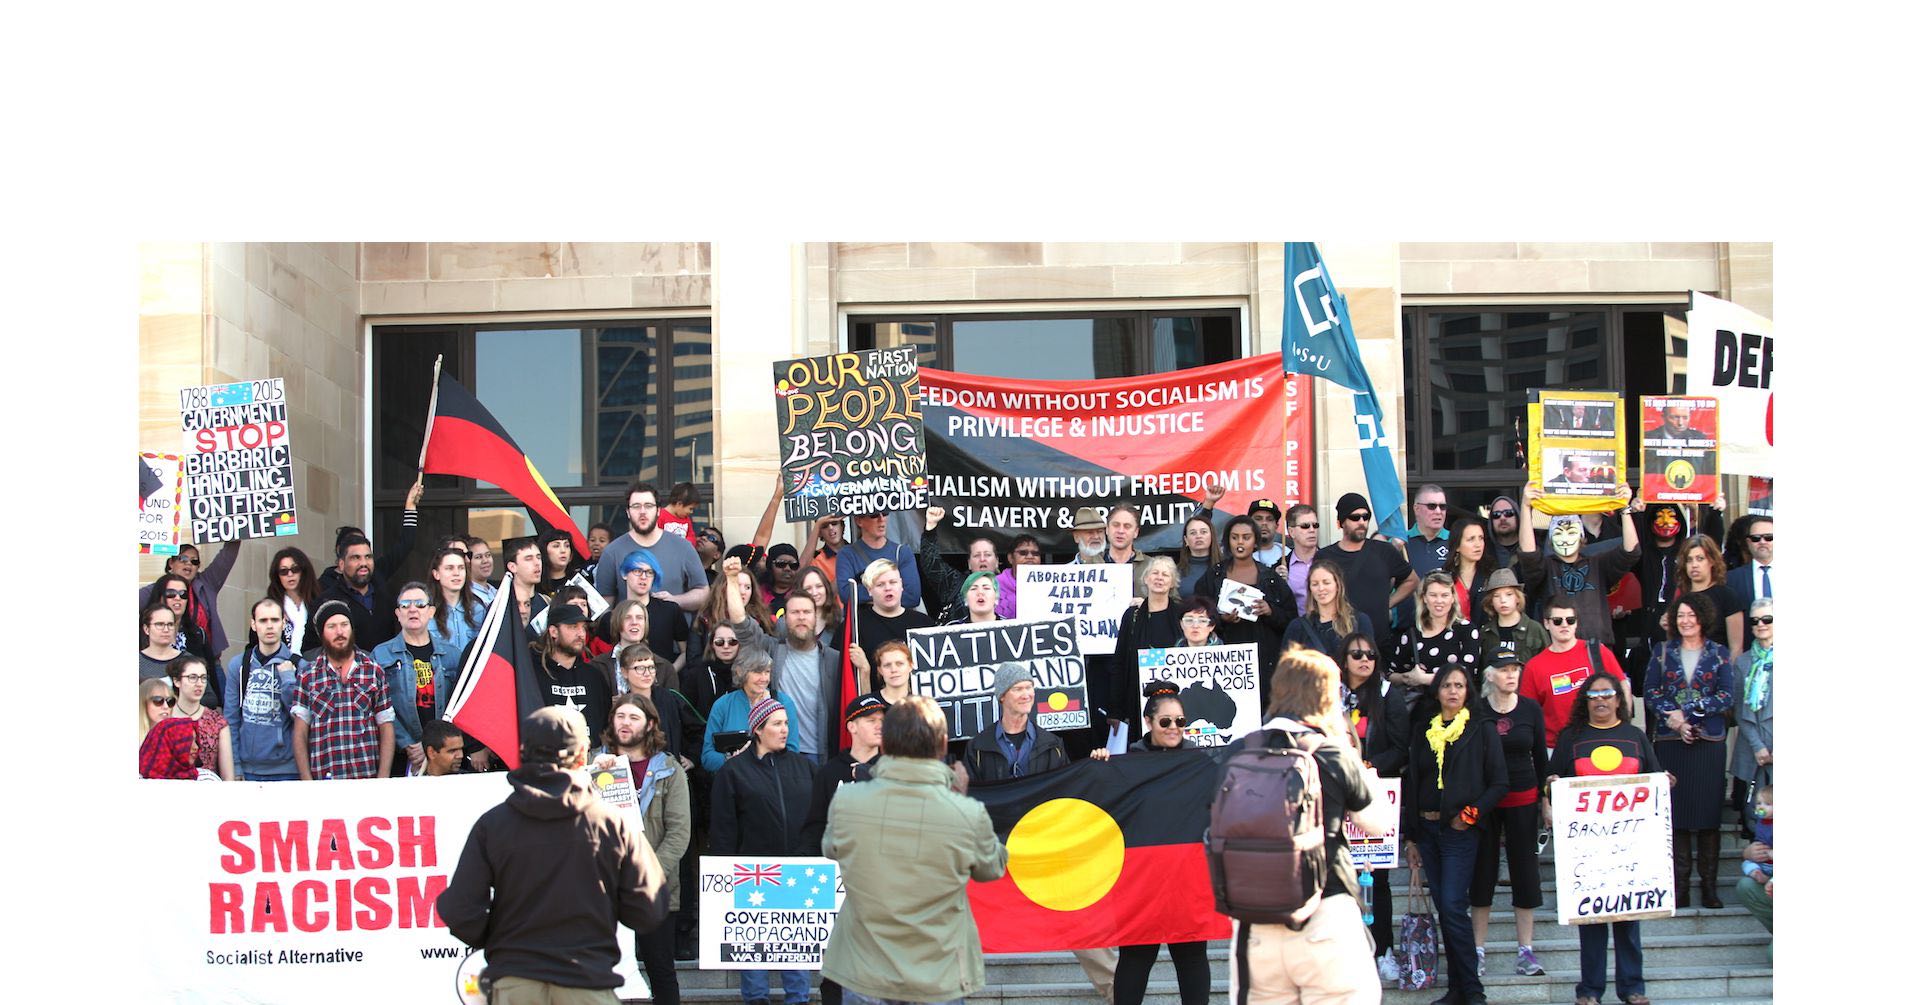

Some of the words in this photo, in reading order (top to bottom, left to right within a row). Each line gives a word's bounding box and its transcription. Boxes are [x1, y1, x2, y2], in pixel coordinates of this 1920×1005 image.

[866, 359, 917, 380] NATION
[868, 349, 913, 366] FIRST
[788, 353, 869, 389] OUR
[181, 386, 208, 409] 1788
[253, 379, 282, 401] 2015
[783, 374, 922, 435] PEOPLE
[1001, 392, 1110, 411] WITHOUT
[1117, 381, 1239, 409] SOCIALISM
[1244, 377, 1264, 398] IS
[183, 402, 285, 431] GOVERNMENT
[948, 414, 1063, 438] PRIVILEGE
[1069, 418, 1086, 438] &
[1092, 412, 1204, 437] INJUSTICE
[196, 421, 285, 453] STOP
[782, 422, 919, 467] BELONG
[187, 446, 287, 475] BARBARIC
[188, 470, 286, 496] HANDLING
[788, 459, 841, 494] TO
[810, 477, 911, 497] GOVERNMENT
[1016, 475, 1125, 498] WITHOUT
[1131, 470, 1240, 495] FREEDOM
[1245, 469, 1265, 491] IS
[145, 499, 170, 508] UND
[194, 497, 226, 519] ON
[233, 490, 292, 514] FIRST
[841, 488, 928, 515] GENOCIDE
[194, 514, 274, 544] PEOPLE
[953, 506, 1055, 529] SLAVERY
[1057, 507, 1075, 529] &
[1048, 585, 1093, 598] LAND
[1051, 602, 1092, 615] NOT
[909, 623, 1073, 669] NATIVES
[1166, 650, 1253, 665] GOVERNMENT
[916, 666, 996, 698] HOLD
[1029, 658, 1084, 688] AND
[1149, 663, 1253, 681] IGNORANCE
[1223, 676, 1255, 690] 2015
[1039, 711, 1085, 726] 1788-2015
[1567, 818, 1645, 838] BARNETT
[217, 815, 437, 874] SMASH
[702, 874, 734, 893] 1788
[209, 874, 449, 934] RACISM
[1578, 887, 1668, 916] COUNTRY
[725, 911, 838, 925] GOVERNMENT
[724, 927, 829, 942] PROPAGAND
[206, 950, 273, 965] Socialist
[278, 948, 363, 965] Alternative
[730, 953, 762, 962] WAS
[766, 953, 819, 962] DIFFERENT
[731, 943, 755, 952] THE
[763, 943, 815, 953] REALITY
